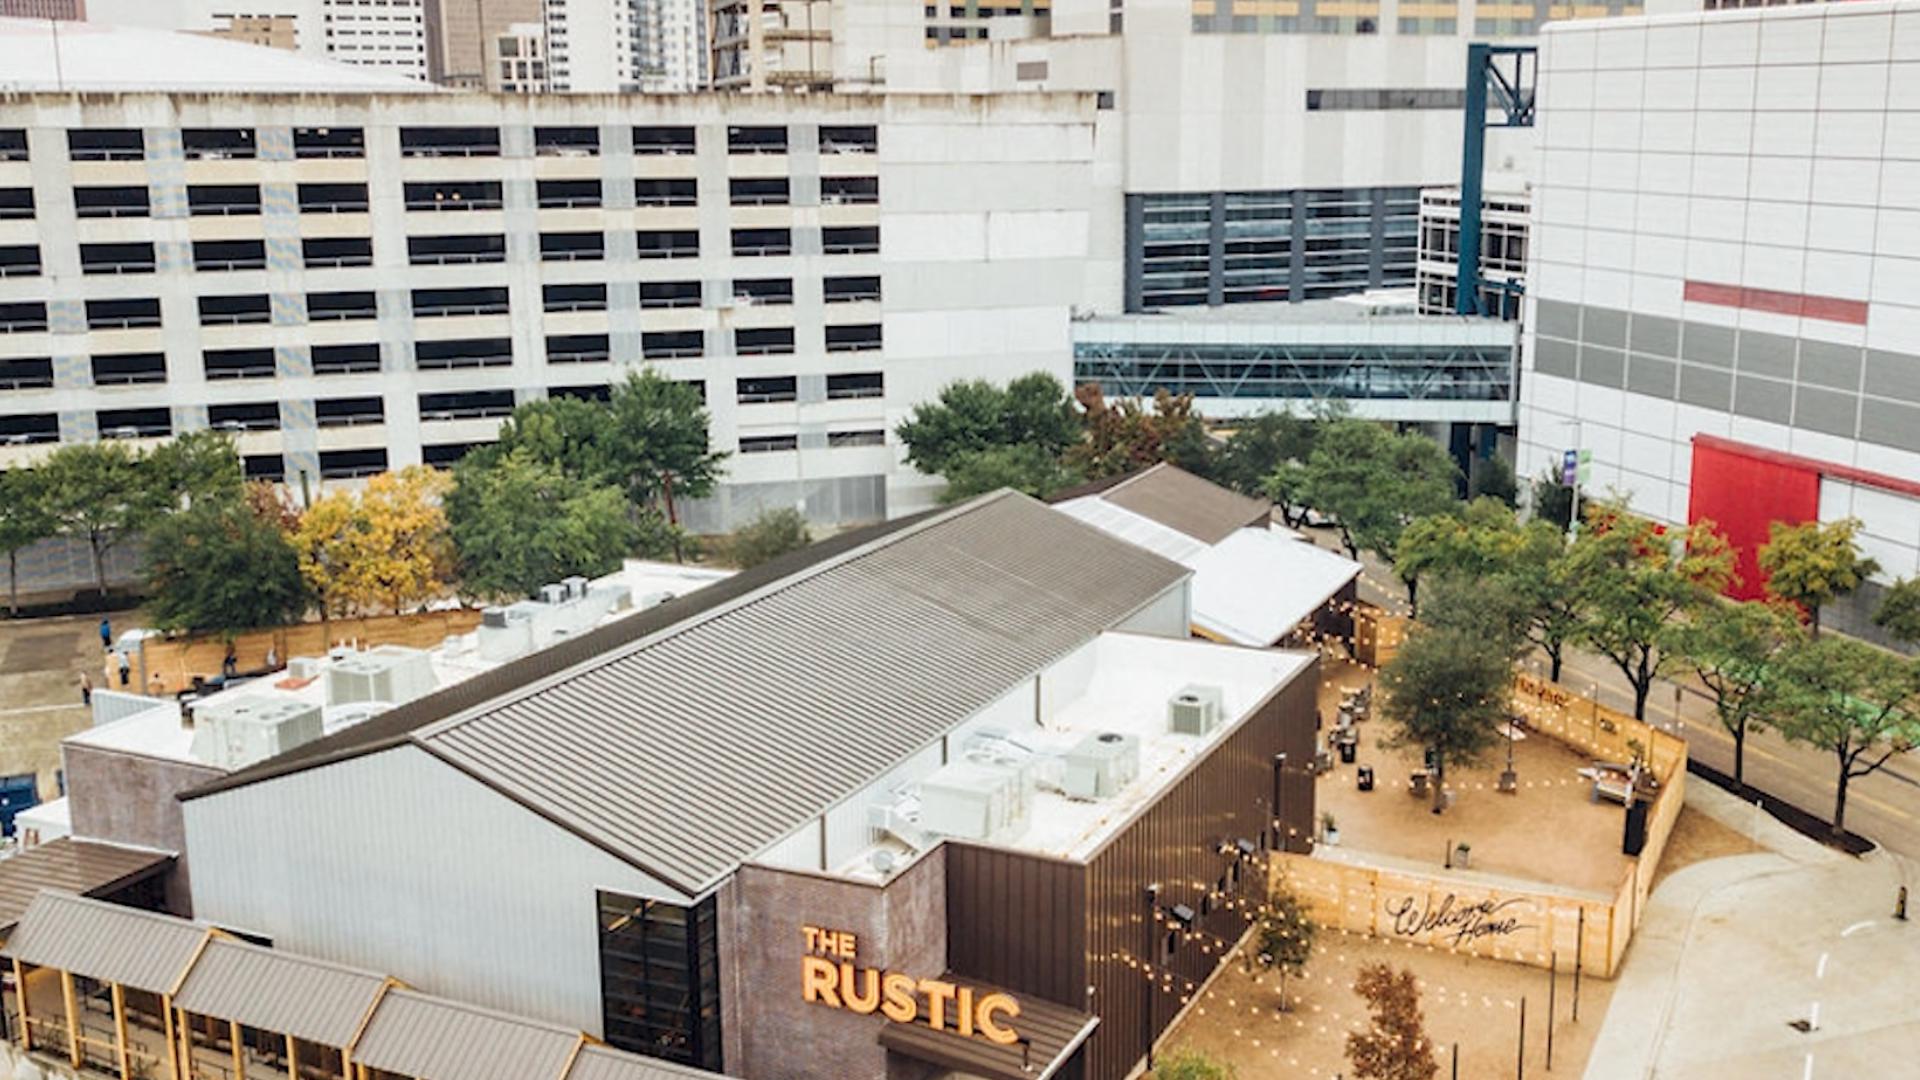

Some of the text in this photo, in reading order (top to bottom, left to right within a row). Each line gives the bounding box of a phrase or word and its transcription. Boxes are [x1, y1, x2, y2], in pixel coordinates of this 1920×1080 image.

[1385, 894, 1527, 935] Welcome
[1444, 918, 1538, 946] Home
[802, 925, 857, 959] THE
[803, 954, 1021, 1045] RUSTIC
